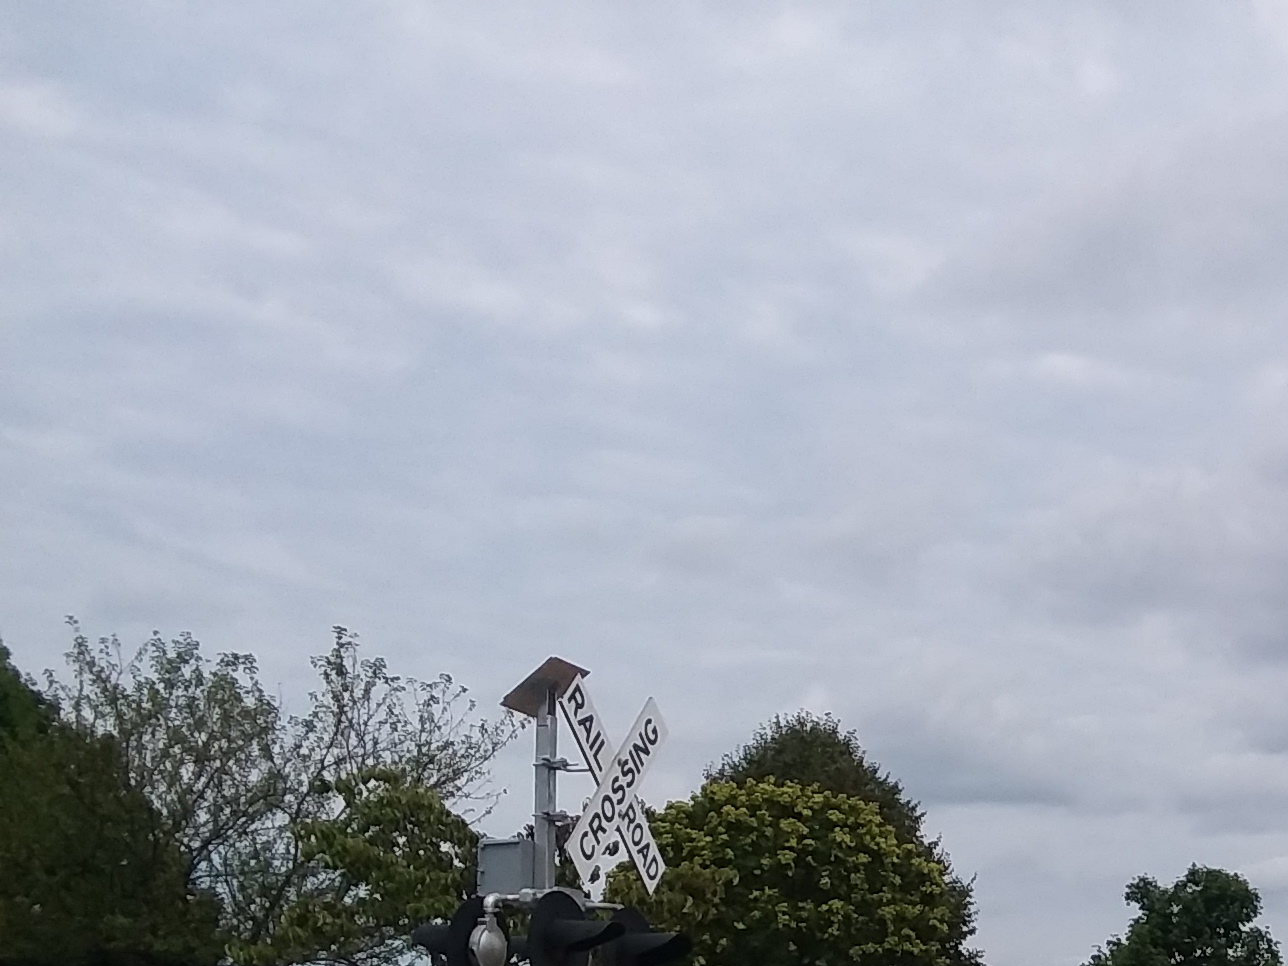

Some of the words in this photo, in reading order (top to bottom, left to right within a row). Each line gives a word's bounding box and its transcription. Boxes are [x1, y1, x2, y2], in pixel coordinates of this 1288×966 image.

[567, 684, 606, 773] RAIL
[579, 717, 659, 861] CROSSING
[622, 802, 660, 881] ROAD
